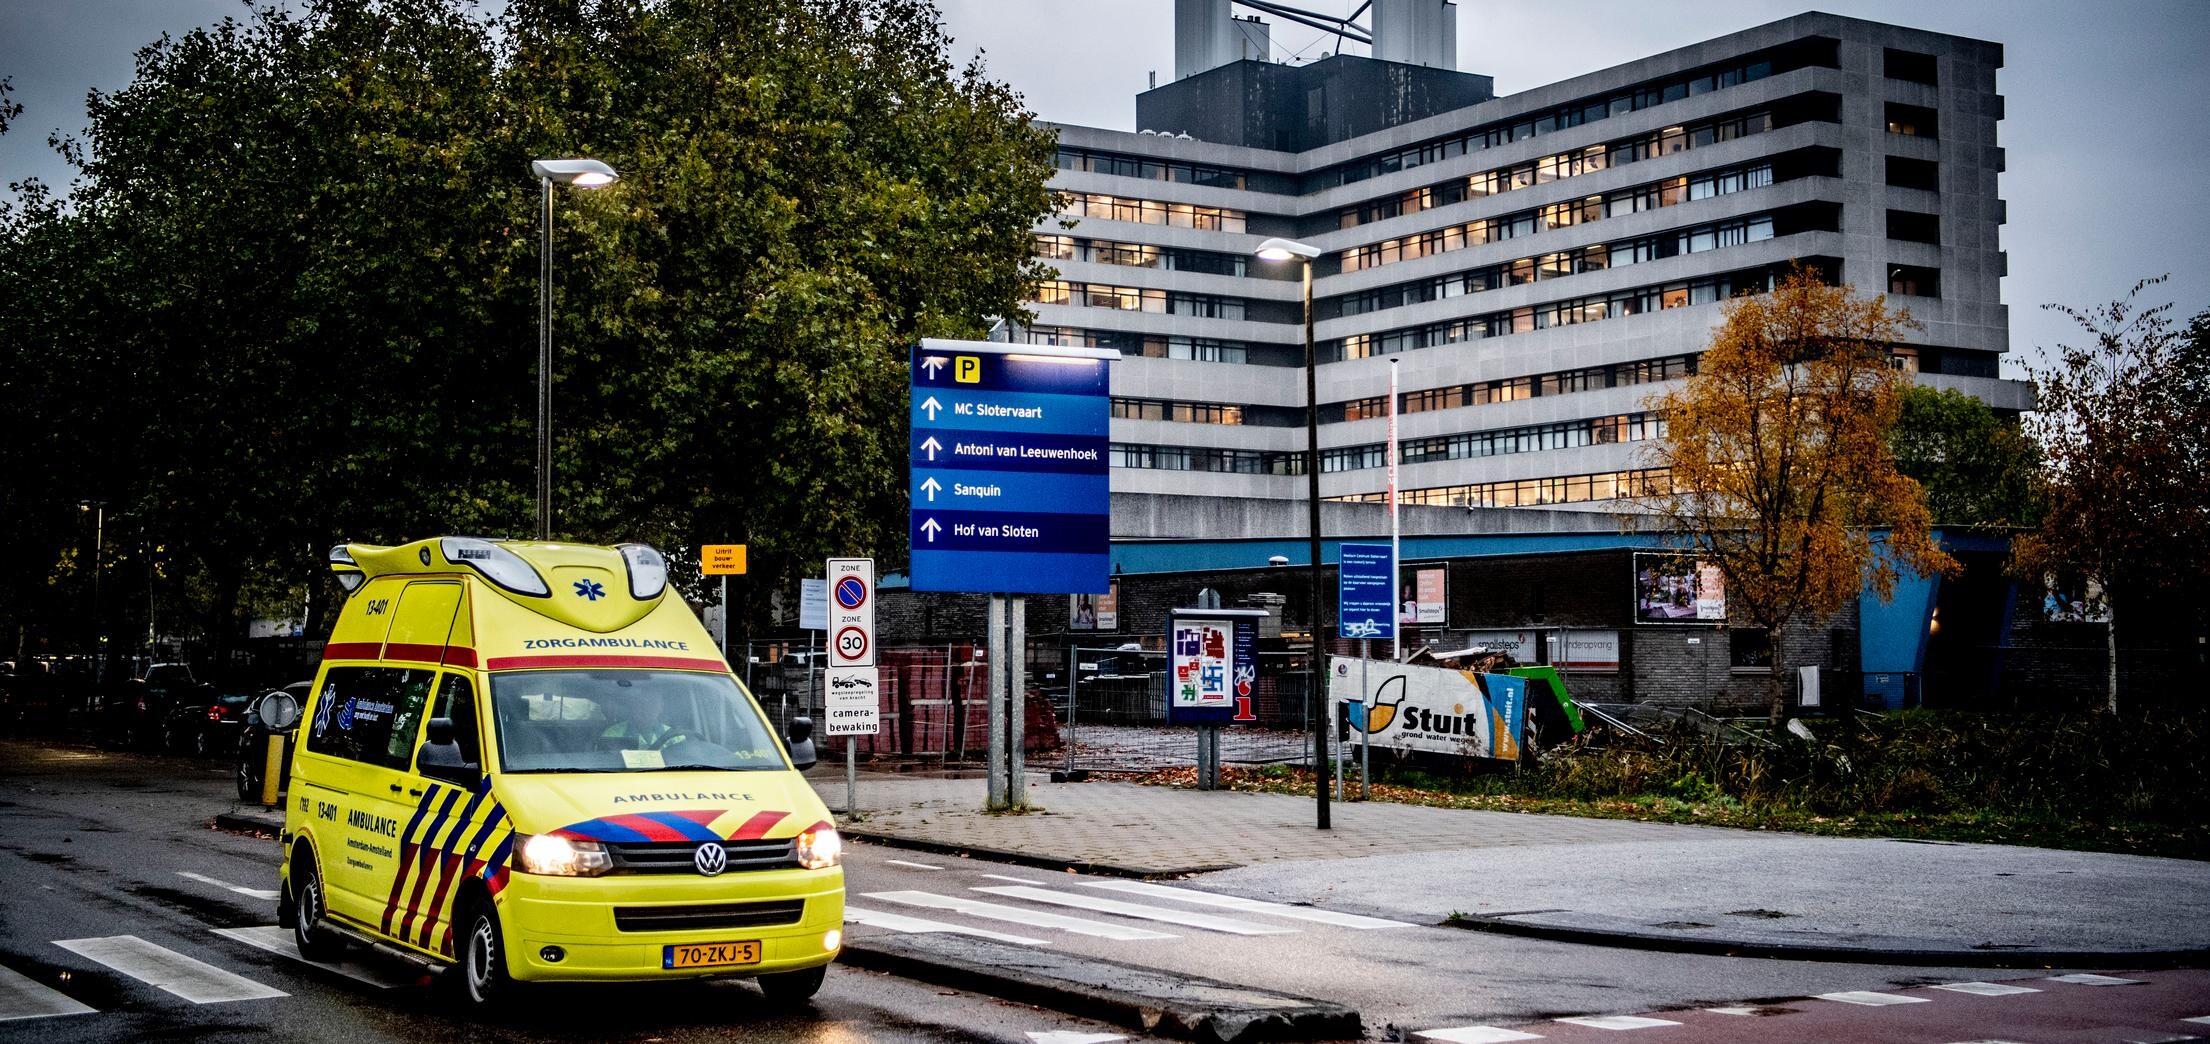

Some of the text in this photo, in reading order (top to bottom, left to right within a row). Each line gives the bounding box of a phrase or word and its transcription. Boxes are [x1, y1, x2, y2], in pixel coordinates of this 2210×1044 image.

[962, 360, 974, 379] P
[955, 403, 1042, 419] MC Slotervaart
[954, 443, 1098, 460] Antoni van Leeuwenhoek
[954, 484, 1001, 498] Sanquin
[954, 524, 1039, 538] Hof van Sloten
[366, 600, 388, 615] 13-401
[524, 638, 689, 650] ZORGAMBULANCE
[842, 637, 863, 650] 30
[1563, 640, 1612, 650] knderopvang
[833, 709, 874, 718] camera-
[1402, 703, 1476, 736] Stuit
[1502, 688, 1514, 752] www.stuit.nl
[830, 723, 878, 735] bewaking
[1426, 734, 1447, 742] water
[1450, 736, 1475, 744] wege
[614, 792, 754, 803] AMBULANCE
[318, 802, 337, 822] 13-401
[348, 809, 397, 838] AMBULANCE
[347, 837, 392, 858] Amsterdam-Amstelland
[680, 945, 752, 964] 70-ZKJ-5
